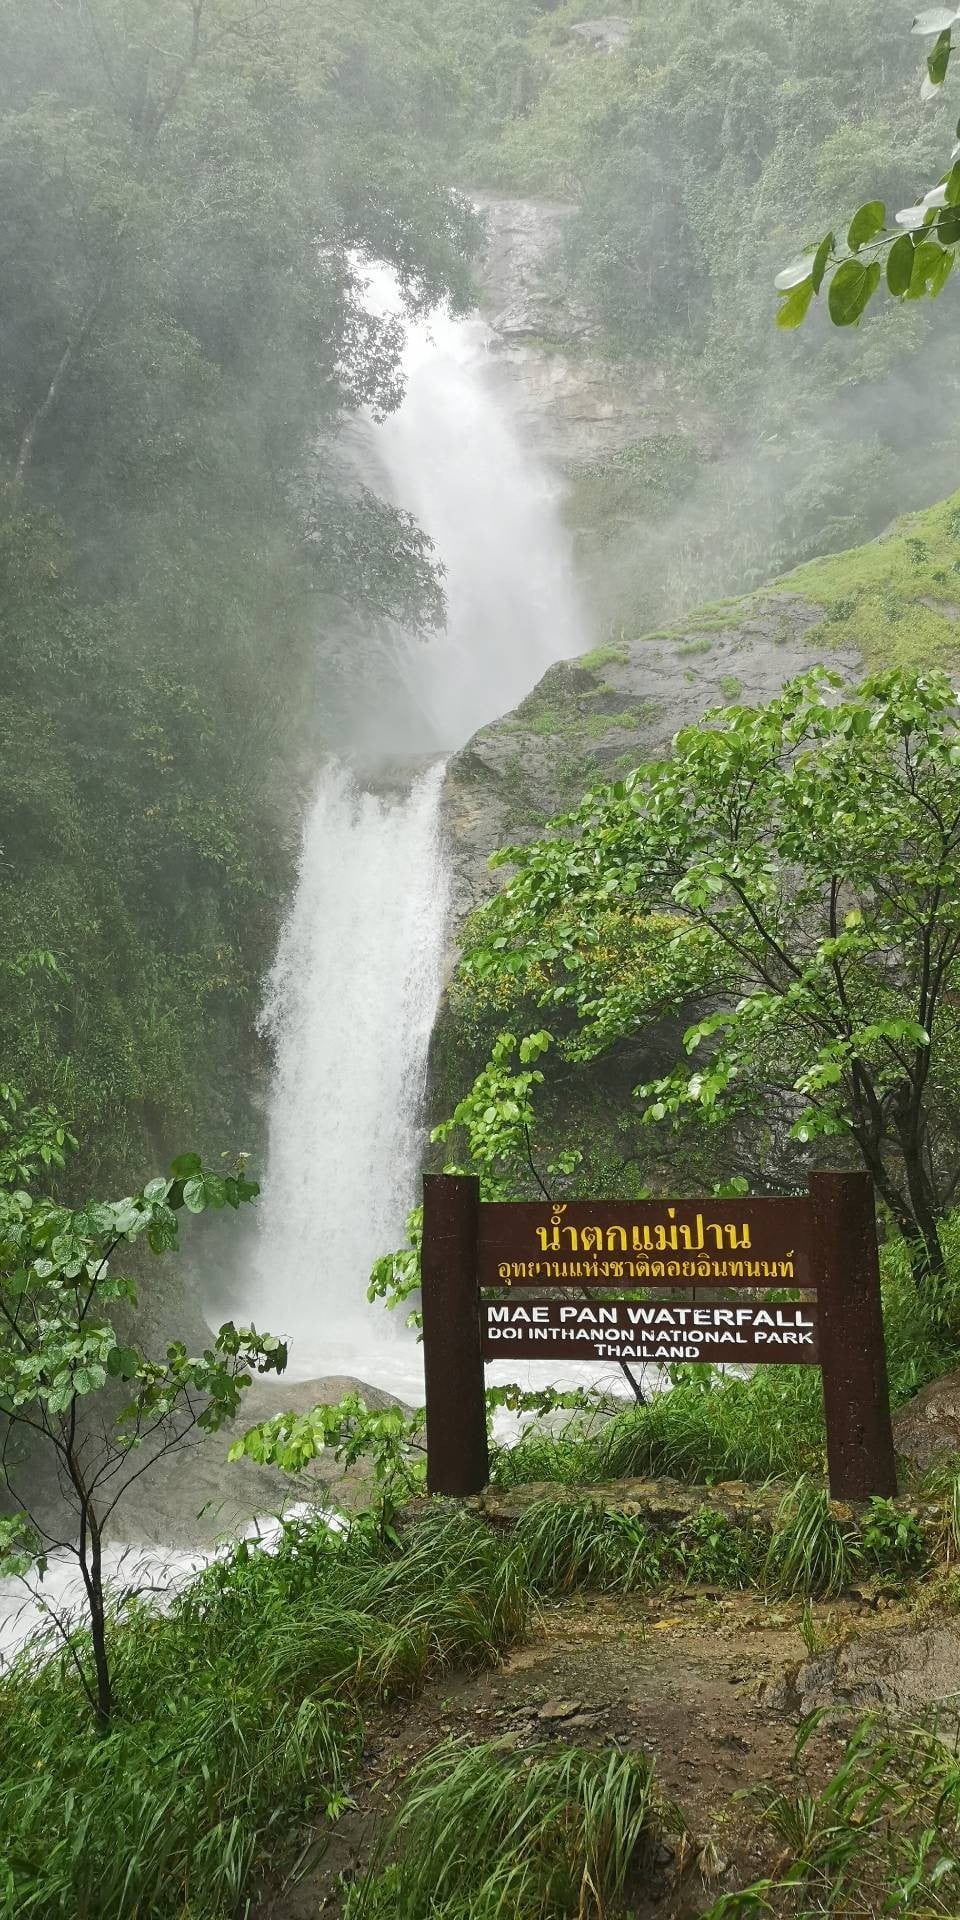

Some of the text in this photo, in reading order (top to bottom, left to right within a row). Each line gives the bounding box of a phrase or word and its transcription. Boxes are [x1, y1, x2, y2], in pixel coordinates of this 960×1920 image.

[535, 1203, 752, 1251] น้ำตกแม่ปาน
[487, 1306, 814, 1327] MAE PAN WATERFALL
[487, 1327, 814, 1344] DOI INTHANON NATIONAL PARK
[594, 1343, 700, 1358] THAILAND
